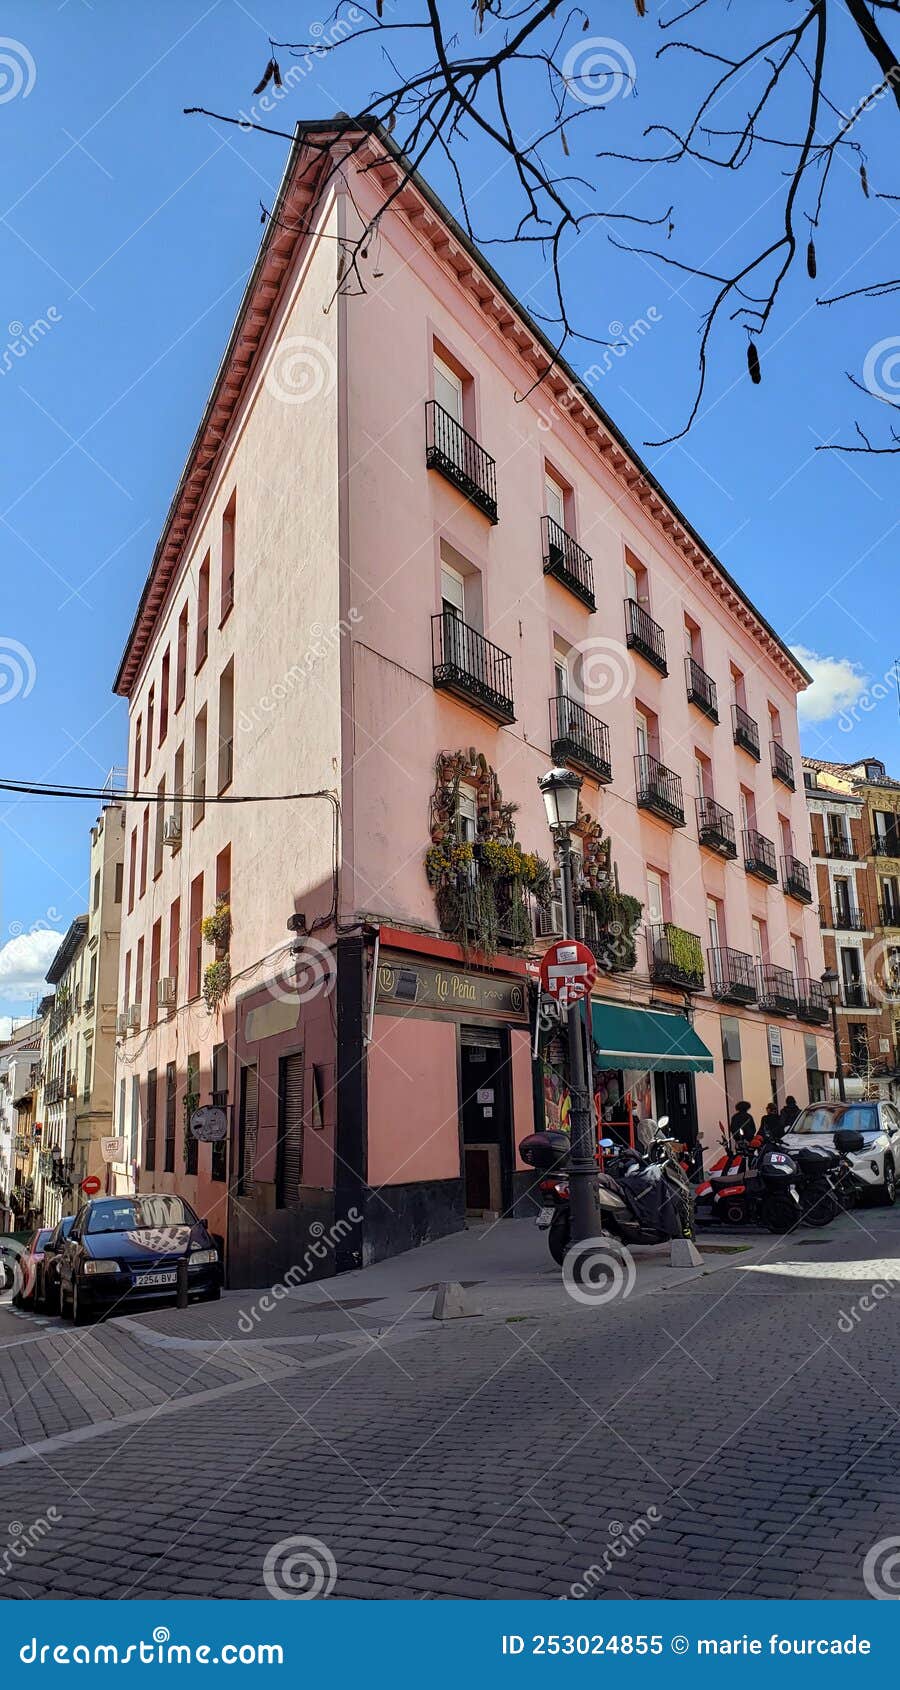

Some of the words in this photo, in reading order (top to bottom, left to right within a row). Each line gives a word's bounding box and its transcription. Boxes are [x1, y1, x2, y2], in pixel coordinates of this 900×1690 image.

[382, 968, 392, 986] 12
[435, 973, 449, 1001] La
[450, 975, 477, 1001] Peña
